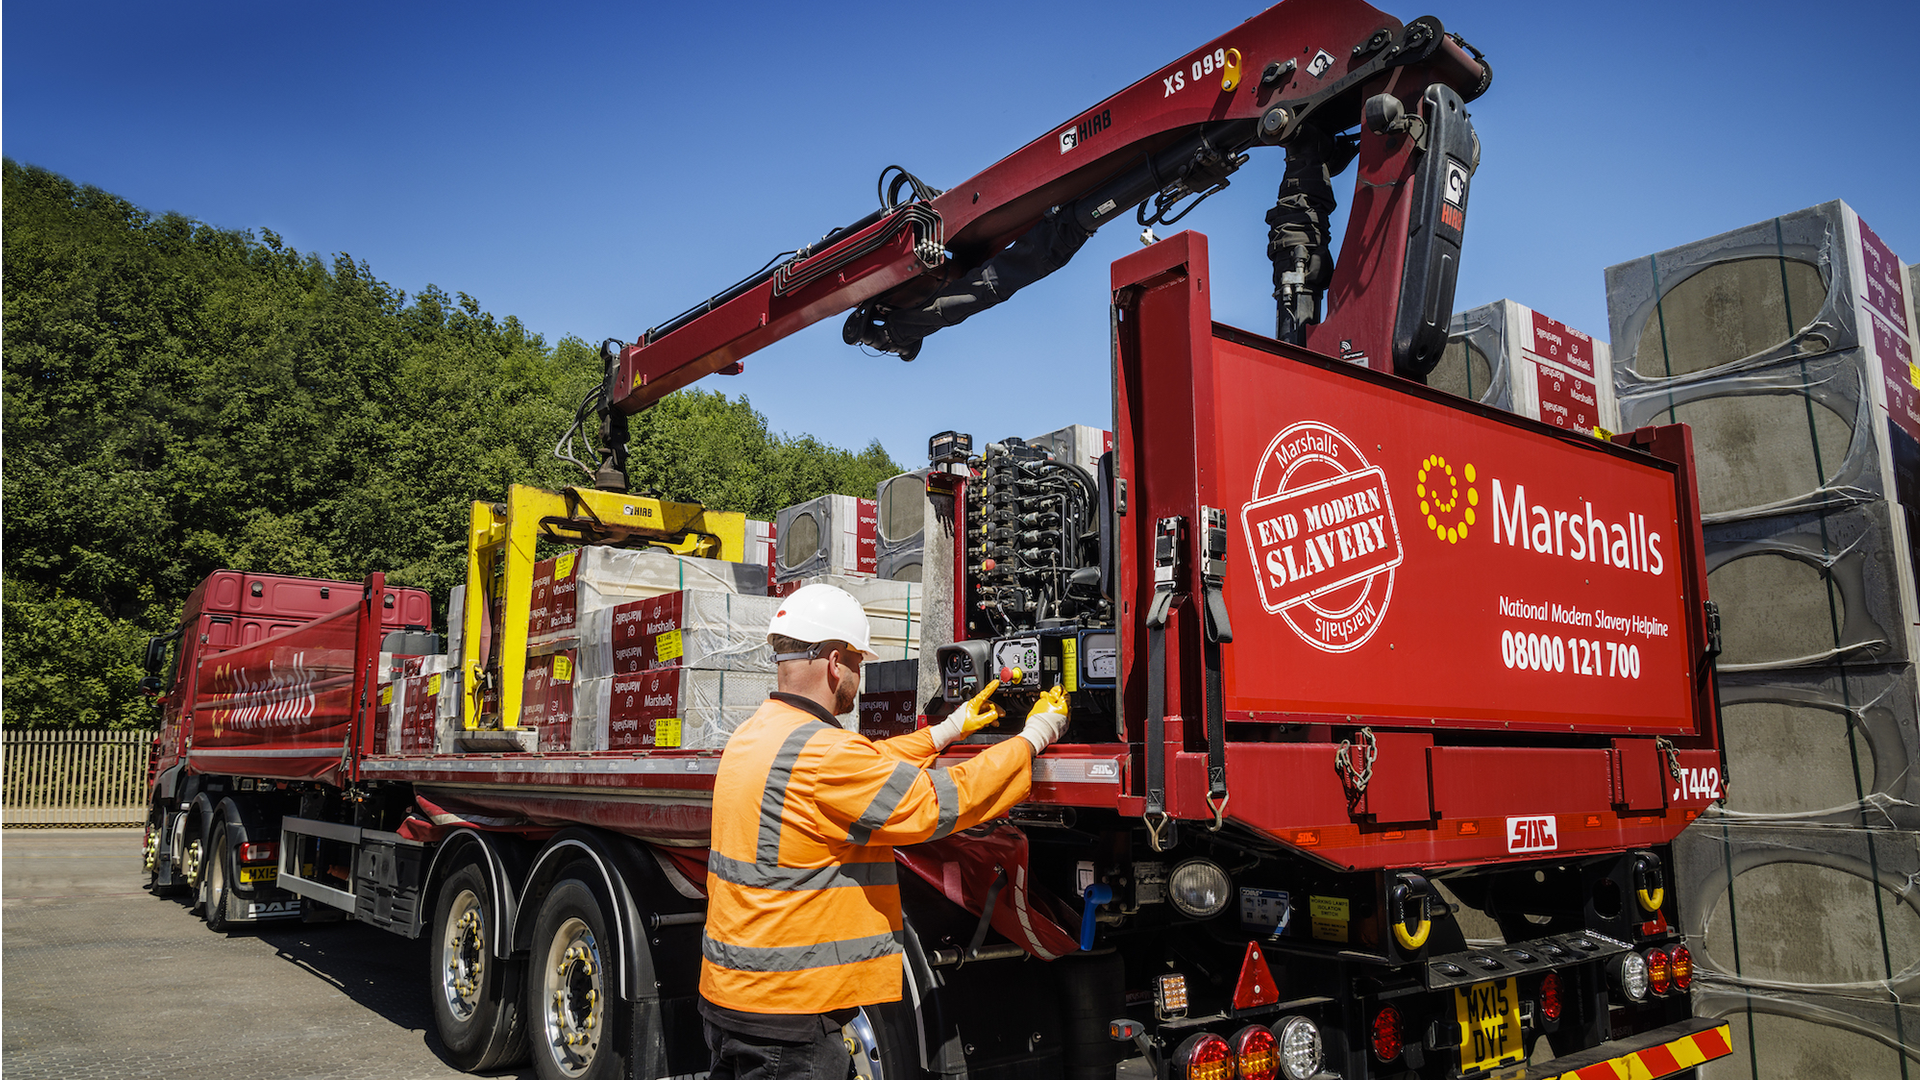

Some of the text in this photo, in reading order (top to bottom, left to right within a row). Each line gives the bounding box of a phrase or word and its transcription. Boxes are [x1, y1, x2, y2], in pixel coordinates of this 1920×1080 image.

[1163, 47, 1226, 98] XS 099
[1079, 109, 1112, 142] HIAB
[1441, 203, 1463, 231] HIAB
[1567, 352, 1591, 371] Marshalls
[1570, 388, 1595, 407] Marshalls
[1275, 431, 1339, 469] Marshalls
[634, 506, 653, 518] HIAB
[1257, 486, 1382, 547] END MODERN
[1492, 478, 1664, 576] Marshalls
[1266, 515, 1387, 589] SLAVERY
[615, 609, 642, 625] Marshalls
[646, 619, 676, 635] Marshalls
[1315, 600, 1377, 642] Marshalls
[1500, 596, 1669, 639] National Modern Slavery Helpline
[615, 646, 642, 660] Marshalls
[1501, 629, 1640, 680] 08000 121 700
[230, 651, 317, 730] Marshalls
[614, 681, 641, 694] Marshalls
[643, 693, 672, 707] Marshalls
[612, 719, 638, 732] Marshalls
[1091, 765, 1114, 775] SDC
[249, 868, 277, 880] MX15
[249, 901, 301, 913] DAF
[1466, 985, 1509, 1023] MX15
[1473, 1023, 1508, 1063] DYF
